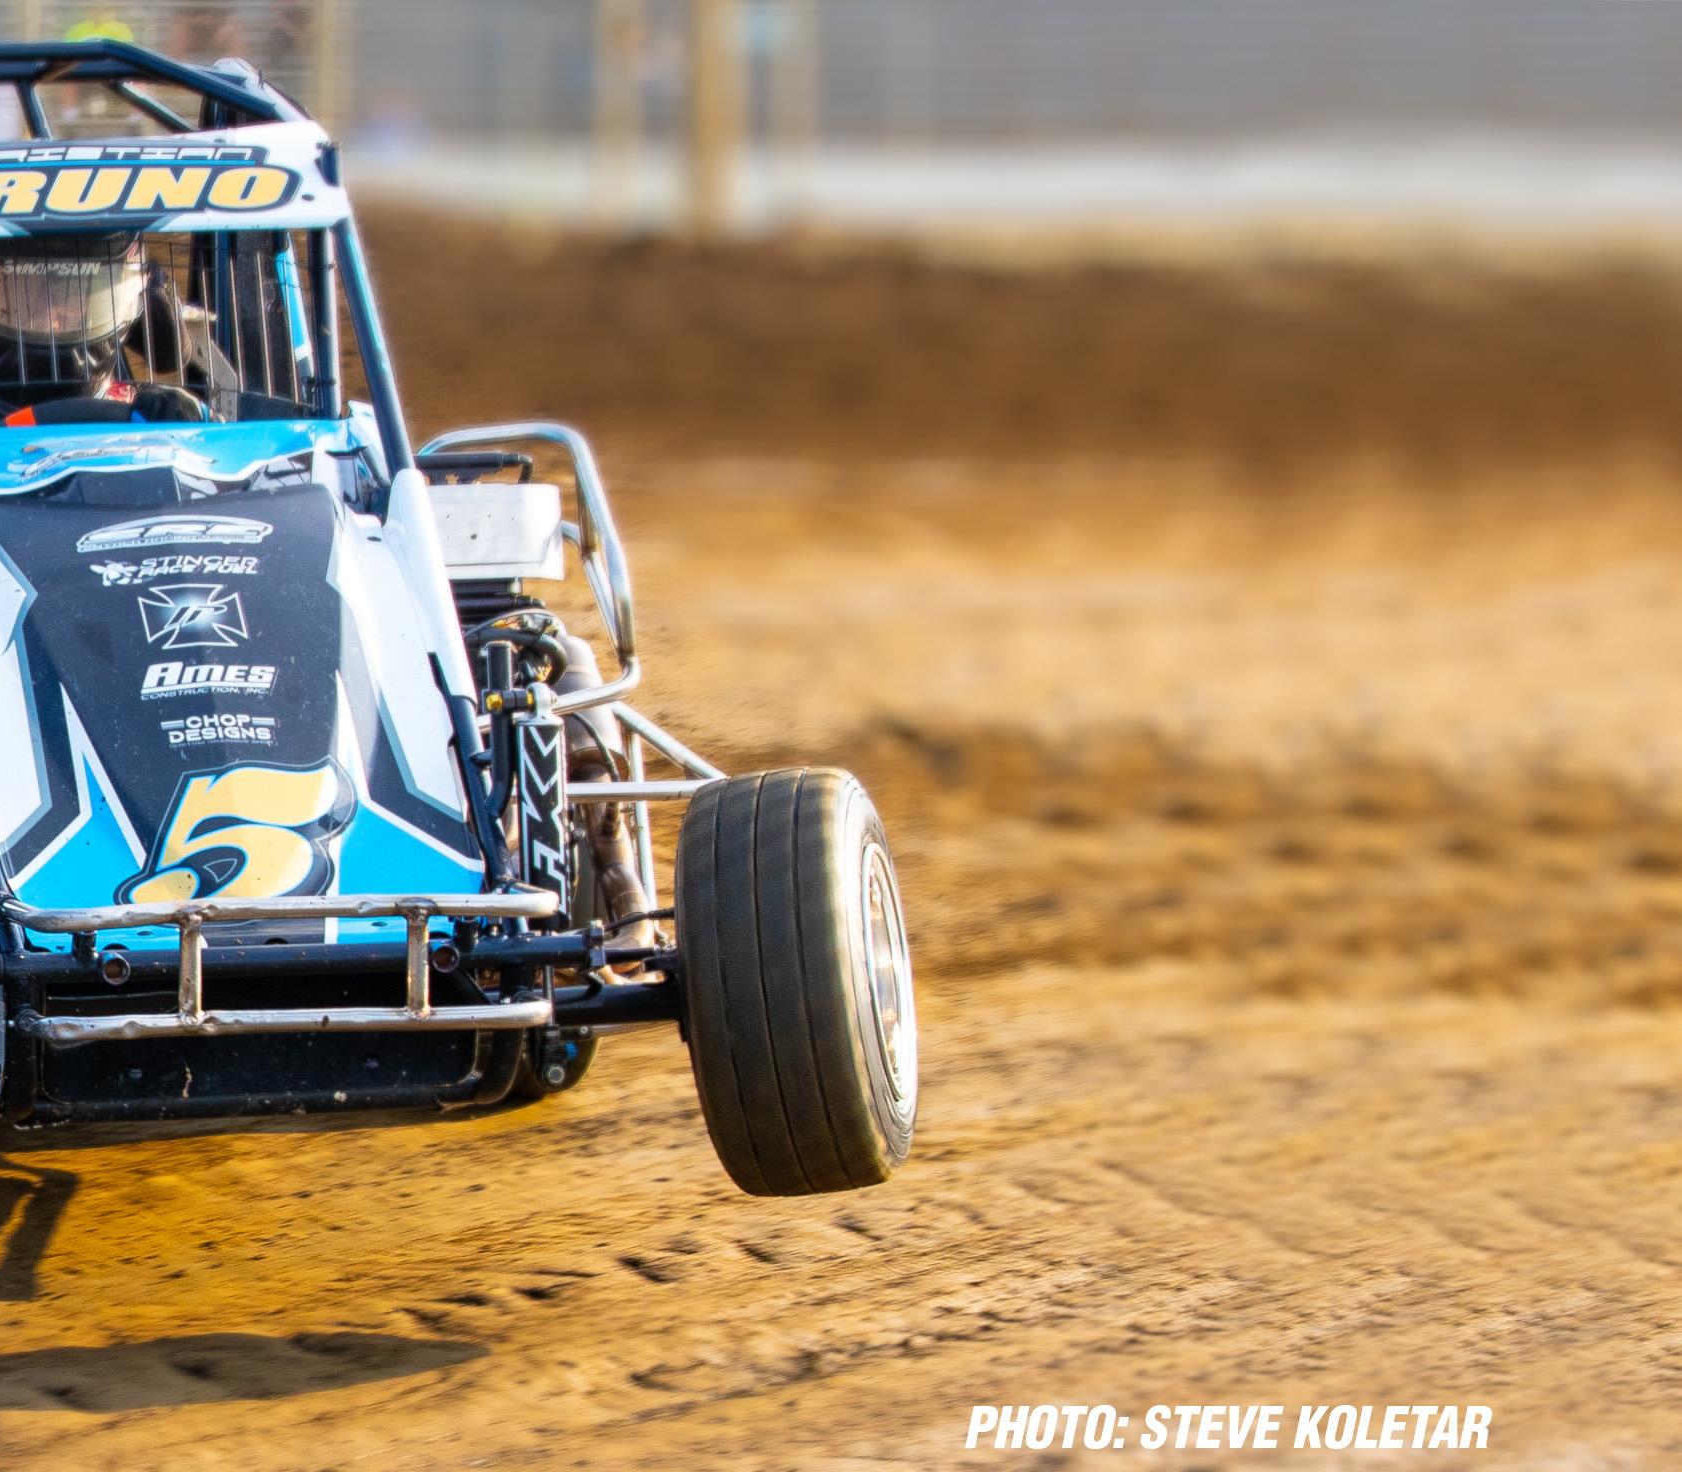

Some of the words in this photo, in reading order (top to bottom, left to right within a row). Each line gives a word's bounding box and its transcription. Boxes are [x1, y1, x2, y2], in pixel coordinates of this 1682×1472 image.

[141, 555, 259, 568] STINGER
[138, 564, 196, 578] RACE
[203, 563, 259, 575] FUEL
[186, 714, 250, 728] CHOP
[169, 727, 272, 744] DESIGNS
[127, 762, 340, 905] 5
